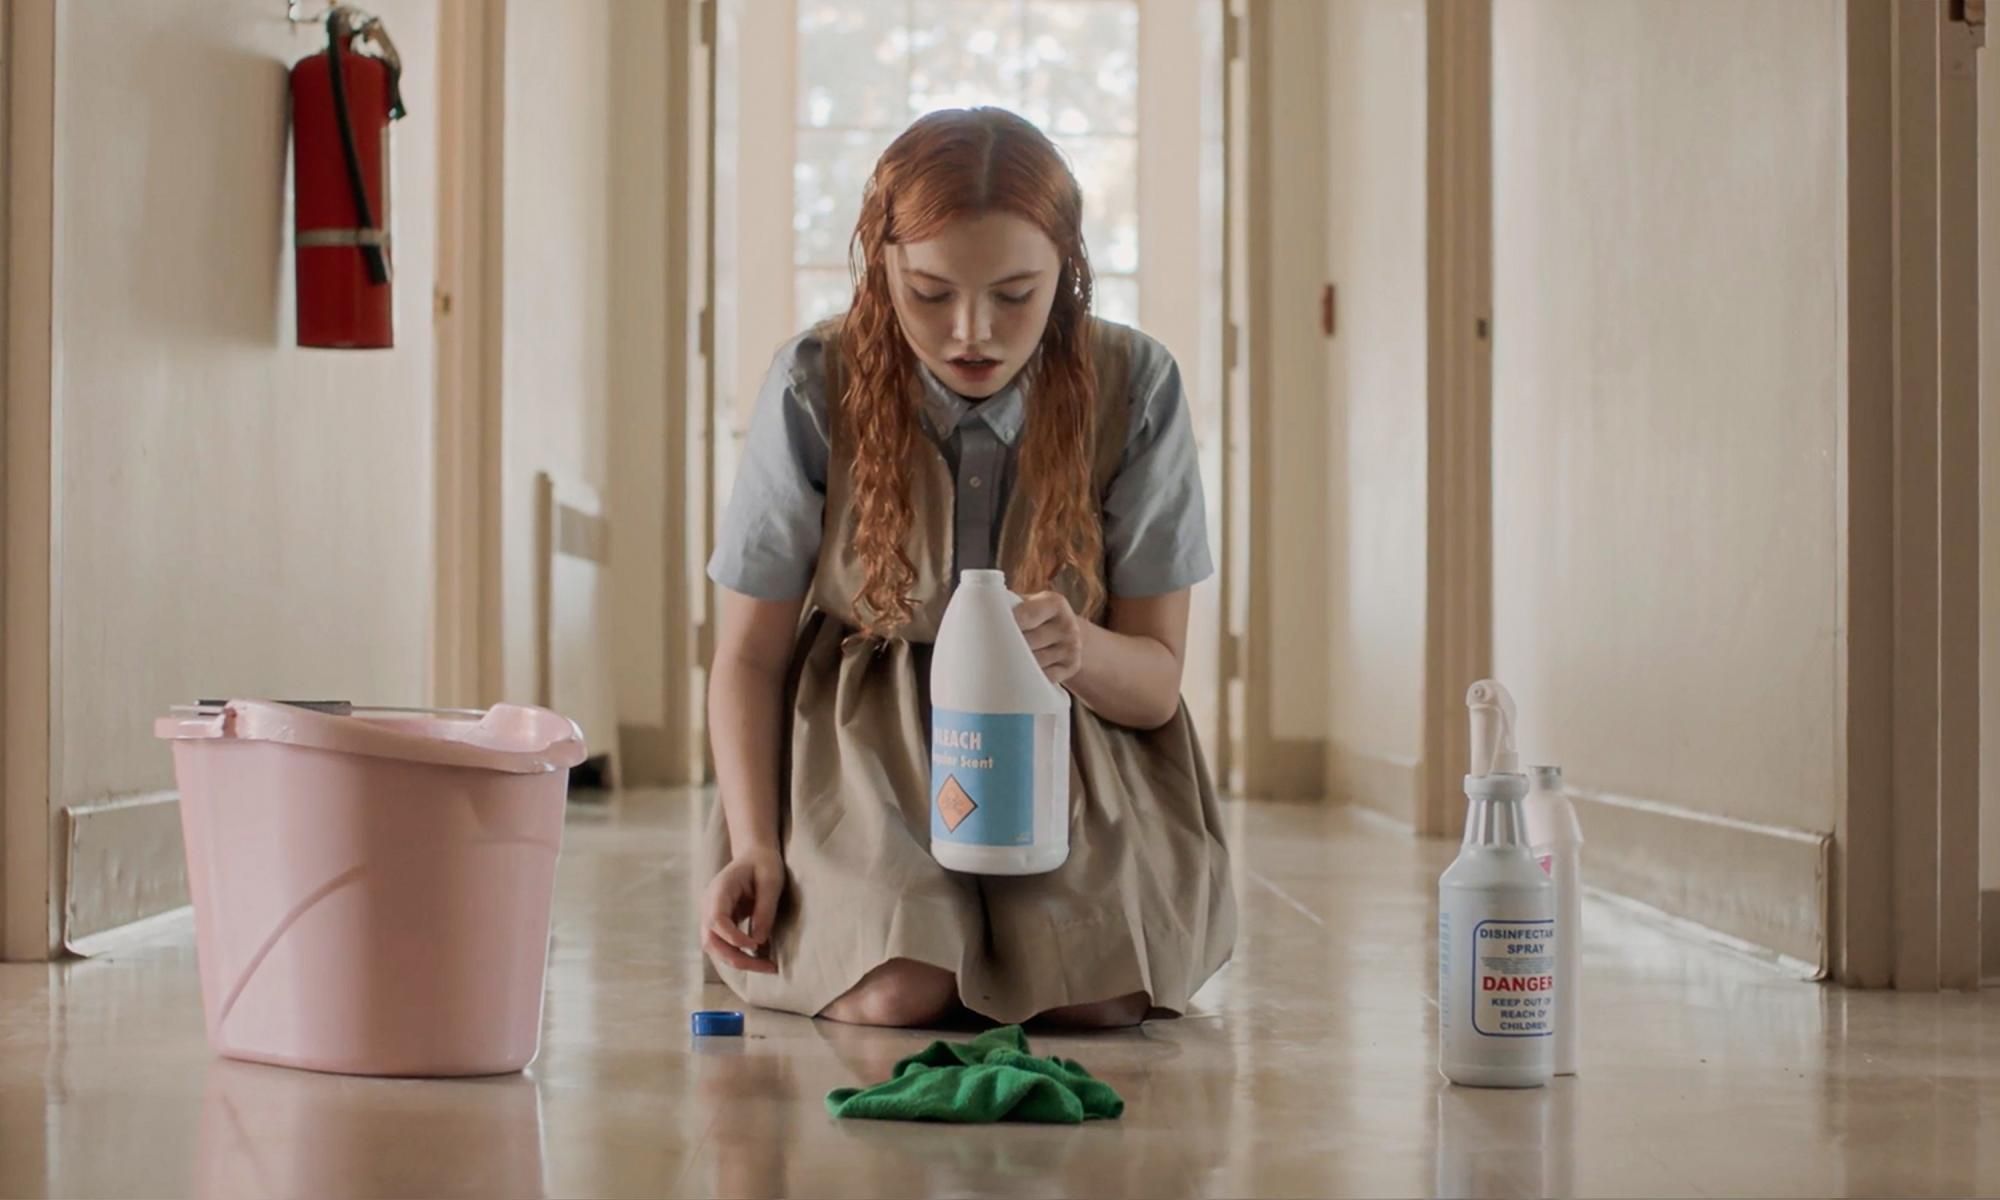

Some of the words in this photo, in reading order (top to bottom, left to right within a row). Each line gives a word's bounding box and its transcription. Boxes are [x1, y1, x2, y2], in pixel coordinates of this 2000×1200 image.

[960, 754, 994, 769] Scent
[1507, 943, 1545, 955] SPRAY
[1491, 998, 1521, 1007] KEEP
[1523, 998, 1542, 1007] OUT
[1501, 1010, 1536, 1019] REACH
